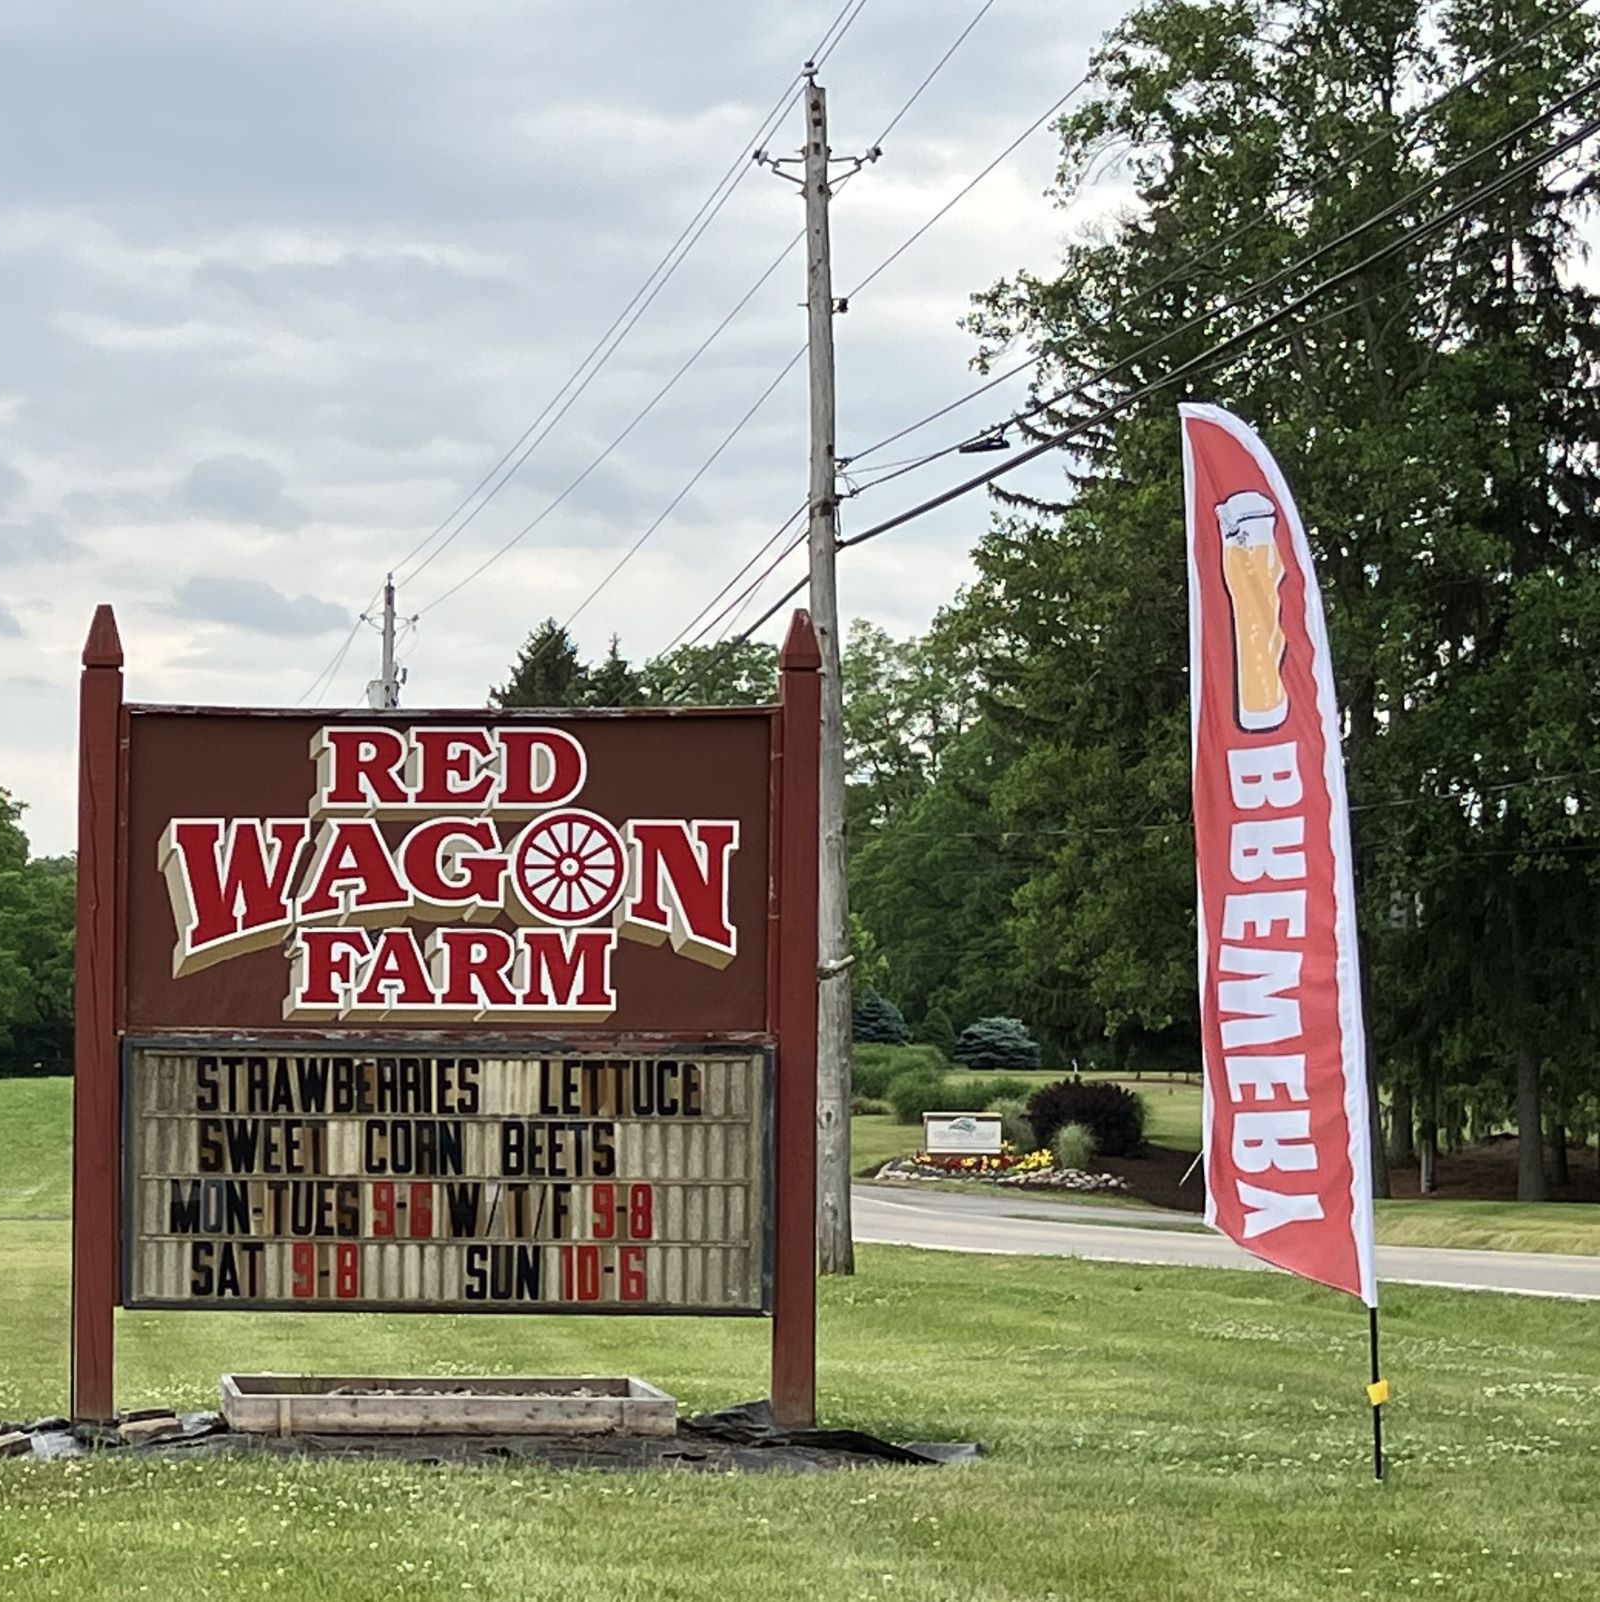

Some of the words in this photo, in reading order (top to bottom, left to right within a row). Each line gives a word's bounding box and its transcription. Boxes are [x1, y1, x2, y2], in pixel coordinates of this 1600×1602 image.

[318, 725, 587, 812] RED
[166, 809, 739, 960] WAGON
[292, 926, 617, 1012] FARM
[196, 1056, 480, 1114] STRAWBERRIES
[540, 1059, 702, 1116] LETTUCE
[200, 1118, 329, 1174] SWEET
[364, 1119, 463, 1176] CORN
[501, 1121, 615, 1177] BEETS
[591, 1183, 653, 1240] 9-8
[190, 1241, 265, 1298] SAT
[291, 1241, 359, 1299] 9-8
[465, 1244, 541, 1301] SUN
[562, 1245, 646, 1302] 10-6
